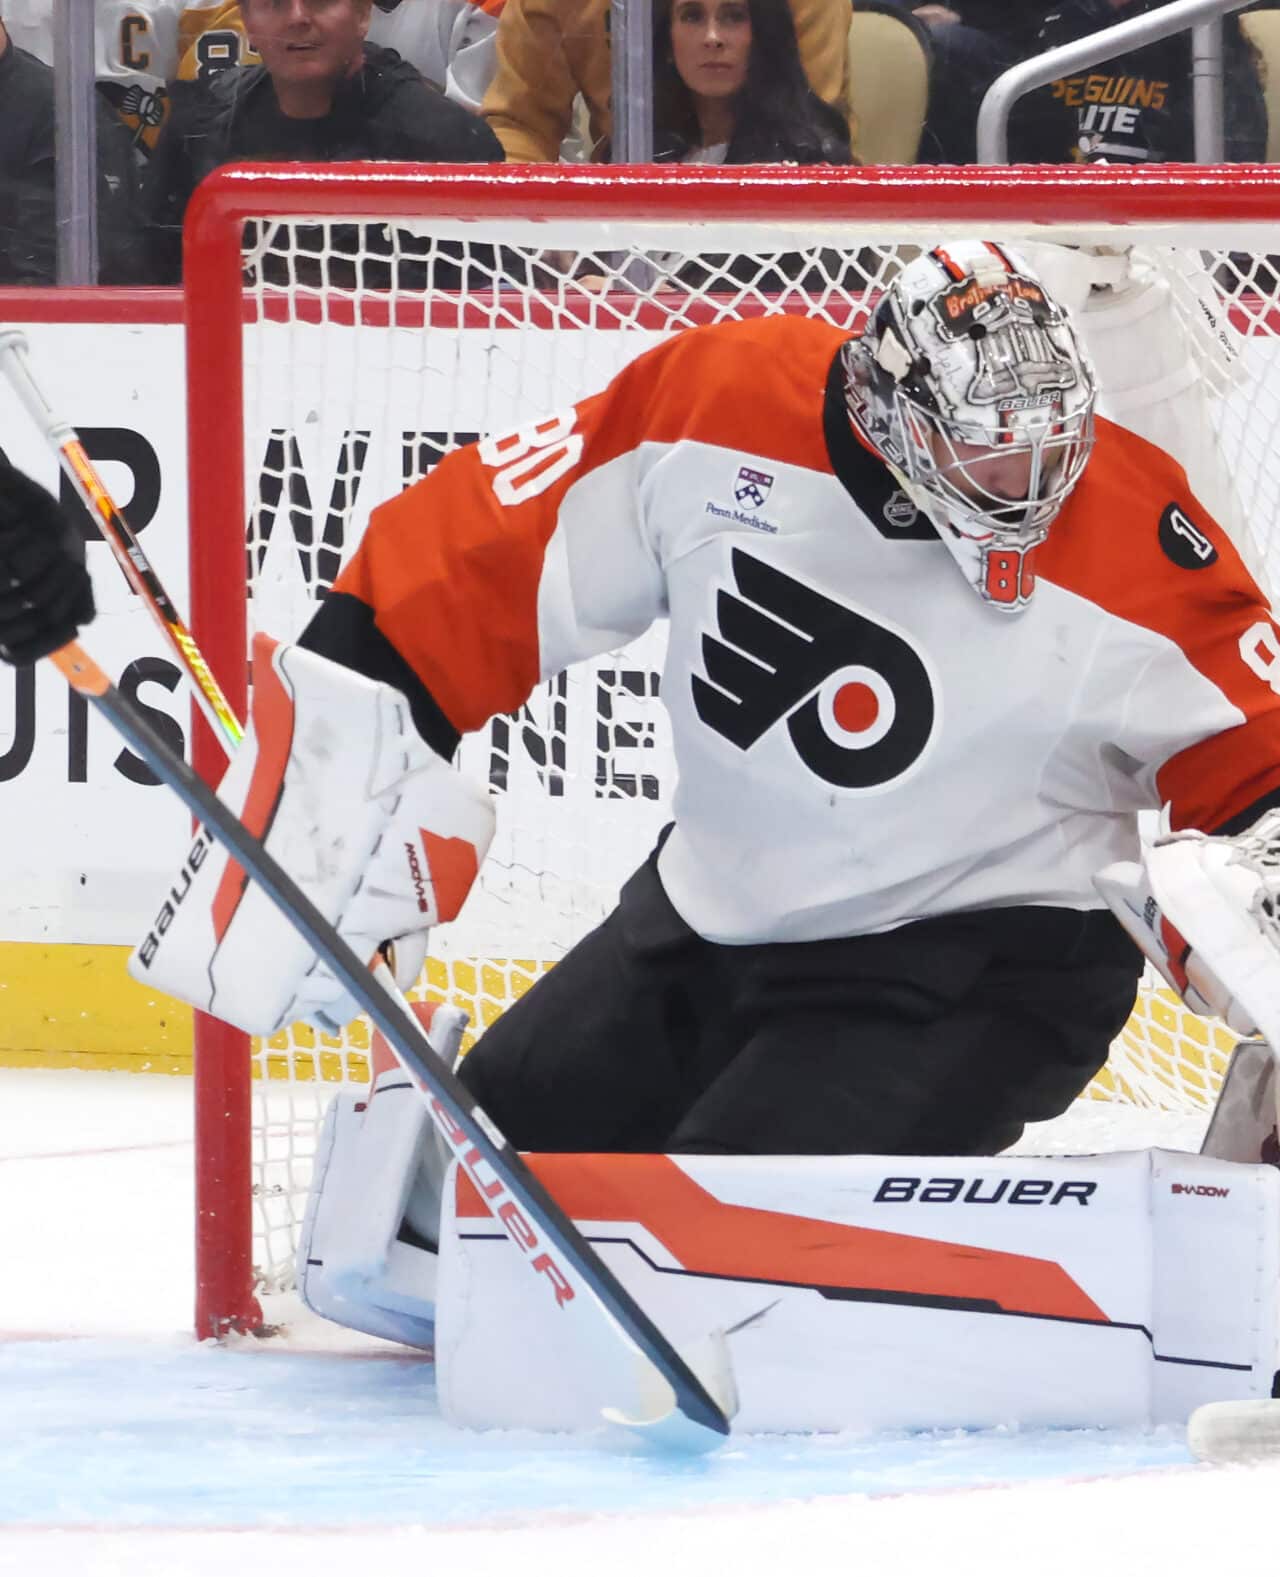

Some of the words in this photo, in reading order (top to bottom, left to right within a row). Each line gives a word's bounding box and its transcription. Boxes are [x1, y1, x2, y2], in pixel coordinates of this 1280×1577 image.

[120, 14, 150, 70] C
[196, 30, 260, 79] 8
[477, 407, 584, 506] 80
[705, 502, 731, 519] Penn
[732, 511, 778, 535] Medicine
[420, 1080, 576, 1311] AUER
[873, 1176, 1098, 1207] BAUER
[1171, 1183, 1230, 1199] SHADOW
